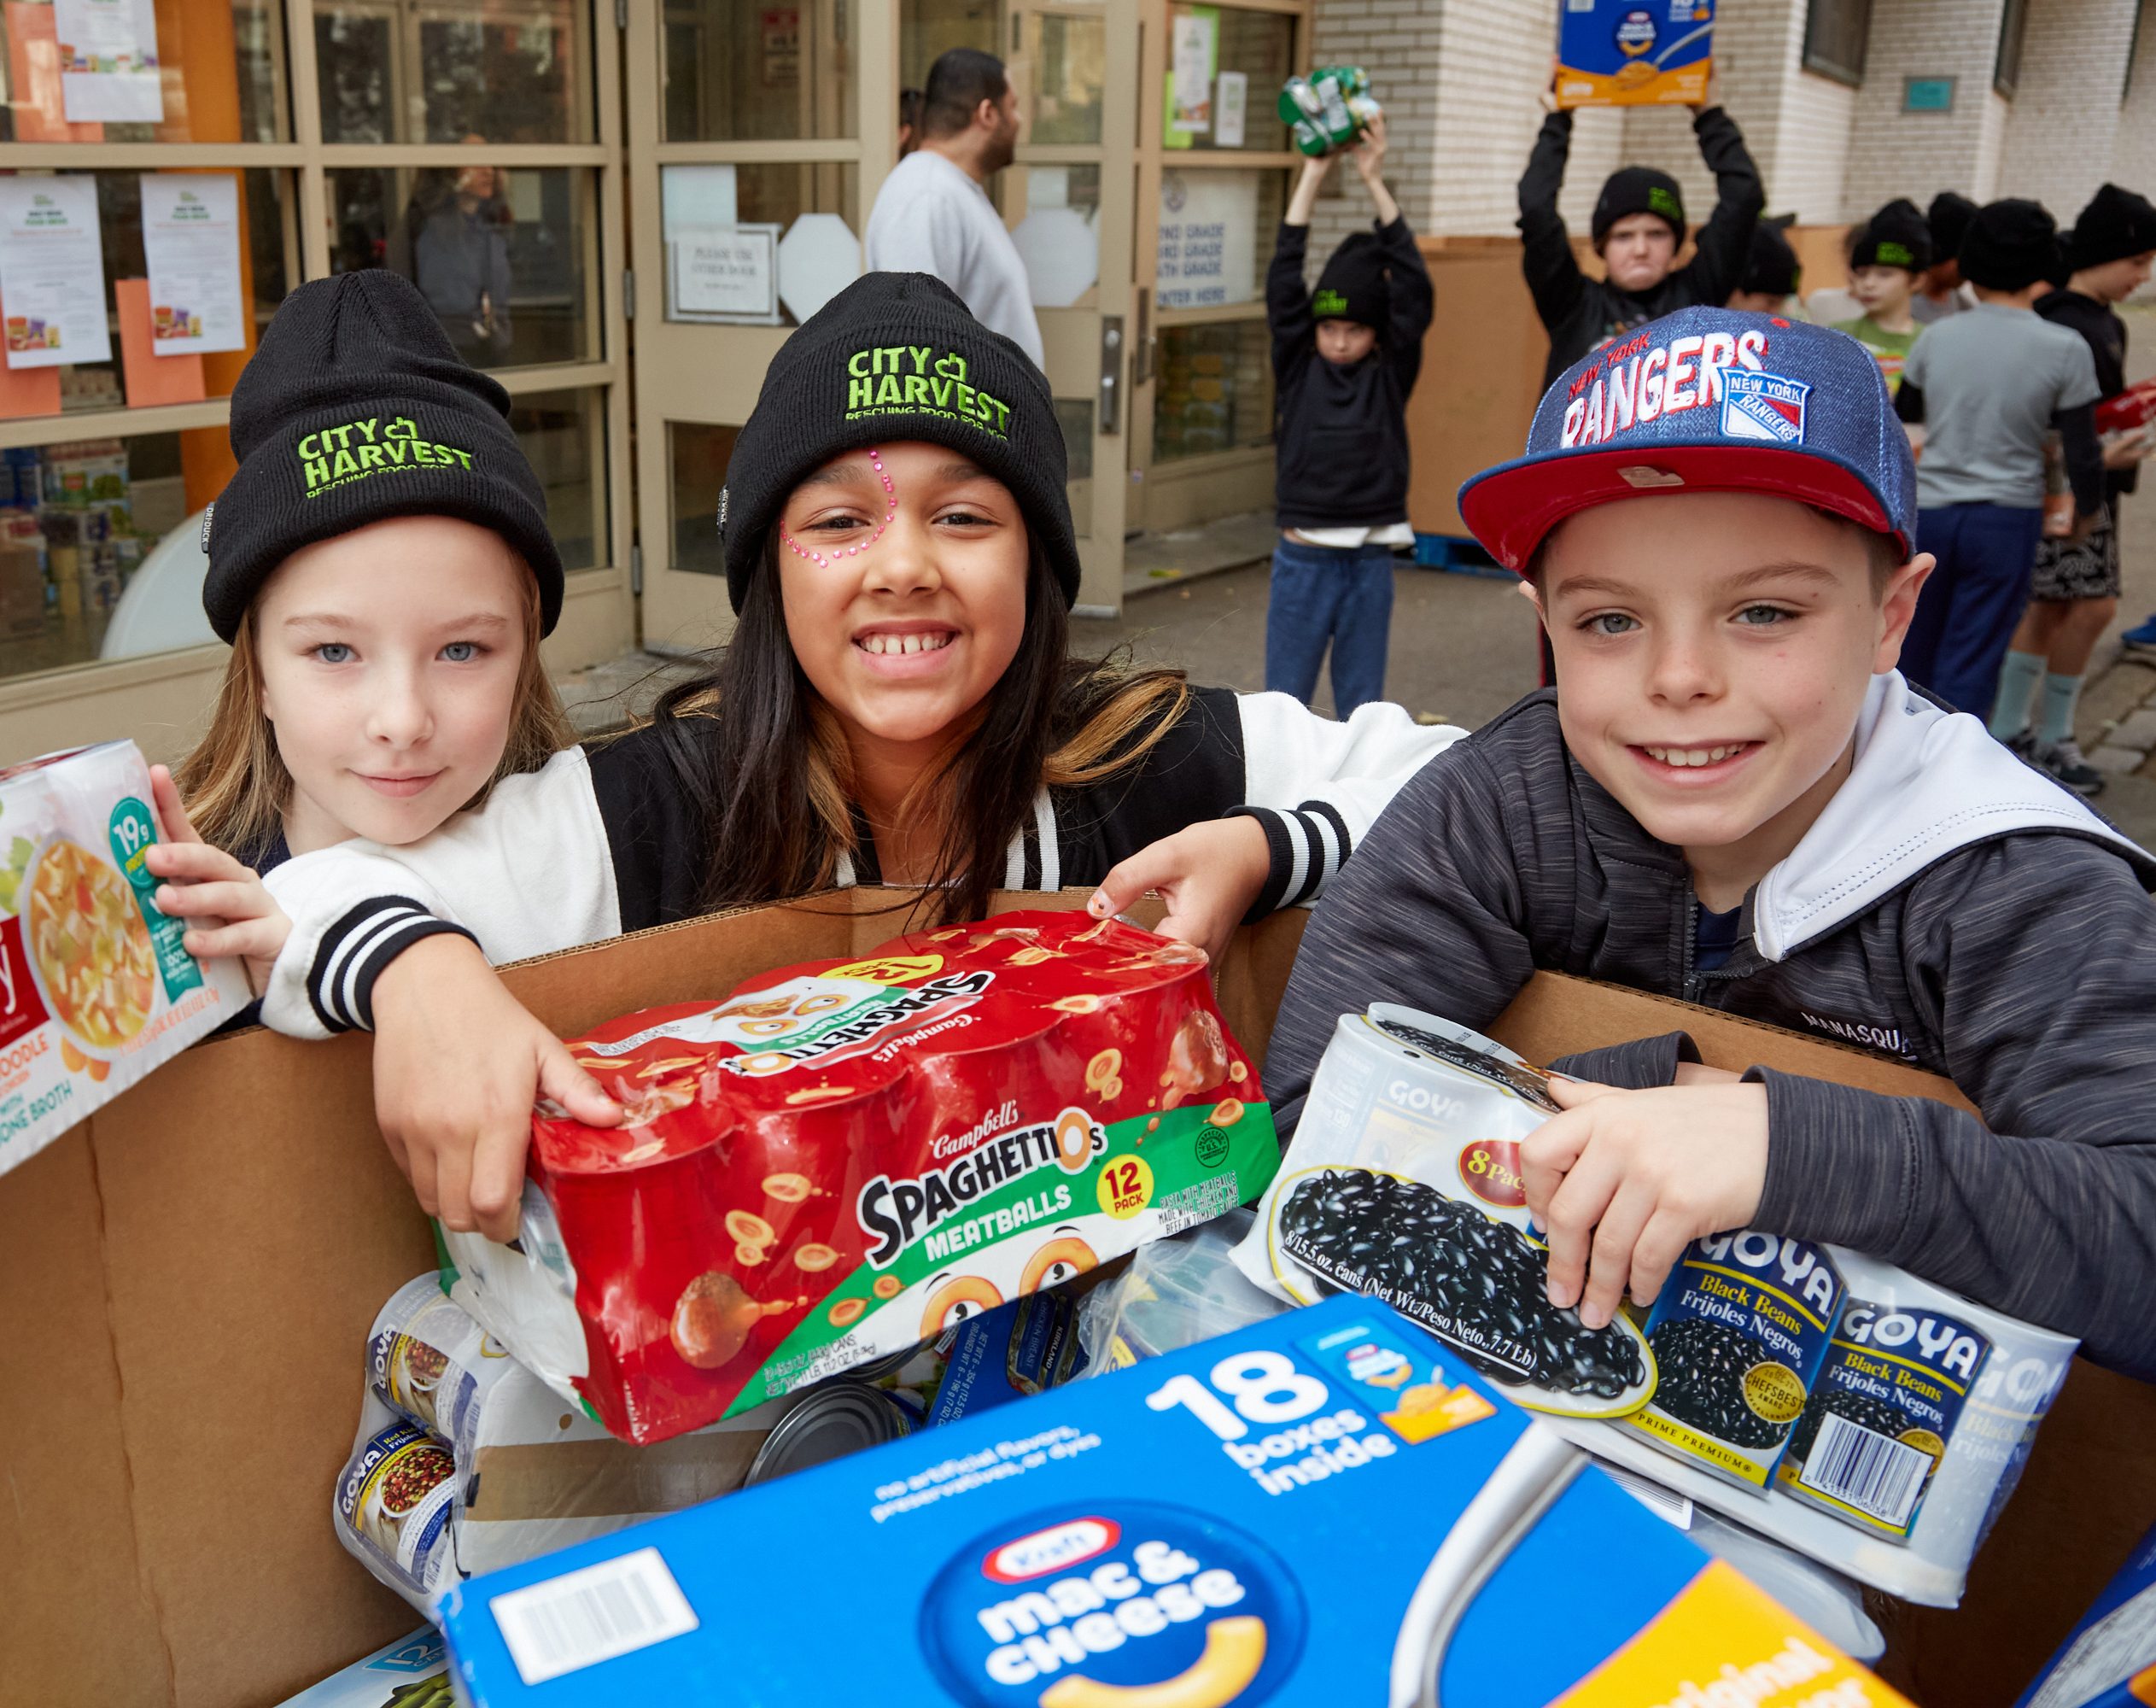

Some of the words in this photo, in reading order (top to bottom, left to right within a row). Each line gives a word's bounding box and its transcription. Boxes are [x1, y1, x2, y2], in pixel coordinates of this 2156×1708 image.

[848, 346, 932, 377] CITY
[1569, 360, 1602, 402] NEW
[1605, 331, 1651, 368] YORK
[849, 374, 1010, 431] HARVEST
[1559, 330, 1768, 449] RANGERS
[1731, 377, 1762, 393] NEW
[1766, 381, 1803, 402] YORK
[299, 418, 377, 460] CITY
[1738, 394, 1800, 442] RANGERS
[304, 440, 471, 489] HARVEST
[0, 1032, 50, 1078] OODLE
[29, 1079, 72, 1122] BROTH
[1389, 1079, 1465, 1120] GOYA
[929, 1099, 1020, 1159] Campbell's
[1104, 1161, 1142, 1201] 12
[1160, 1193, 1182, 1210] PASTA
[1182, 1186, 1198, 1202] WITH
[1199, 1171, 1237, 1196] MEATBALLS
[1467, 1149, 1490, 1174] 8
[1486, 1162, 1526, 1192] Pac
[925, 1184, 1072, 1262] MEATBALLS
[1114, 1192, 1145, 1214] PACK
[1159, 1208, 1177, 1225] MADE
[1177, 1201, 1195, 1218] WITH
[1195, 1190, 1224, 1212] CHICKEN
[1224, 1184, 1238, 1200] AND
[1166, 1220, 1183, 1235] BEEF
[1183, 1217, 1192, 1229] IN
[1192, 1205, 1219, 1225] TOMATO
[1316, 1255, 1334, 1272] oz.
[1335, 1261, 1364, 1290] cans
[1364, 1276, 1394, 1303] (Net
[1700, 1231, 1834, 1316] GOYA
[1680, 1289, 1748, 1331] Frijoles
[1750, 1316, 1803, 1360] Negros
[1699, 1274, 1750, 1307] Black
[1753, 1294, 1803, 1336] Beans
[375, 1323, 396, 1389] GOYA
[979, 1331, 989, 1348] NET
[1045, 1325, 1064, 1370] KIRKLAND
[1843, 1308, 1978, 1380] GOYA
[1145, 1350, 1329, 1441] 18
[1745, 1372, 1804, 1410] CHEFSBEST
[1828, 1365, 1890, 1400] Frijoles
[1890, 1386, 1945, 1425] Negros
[1844, 1352, 1890, 1382] Black
[1895, 1371, 1943, 1403] Beans
[383, 1433, 400, 1445] Red
[1223, 1409, 1366, 1470] boxes
[1637, 1413, 1677, 1438] PRIME
[874, 1481, 907, 1500] no
[907, 1448, 999, 1491] artificial
[1022, 1450, 1047, 1469] or
[1049, 1433, 1101, 1460] dyes
[1249, 1434, 1397, 1495] inside
[342, 1450, 381, 1514] GOYA
[978, 1563, 1142, 1644] mac
[1133, 1541, 1200, 1584] &
